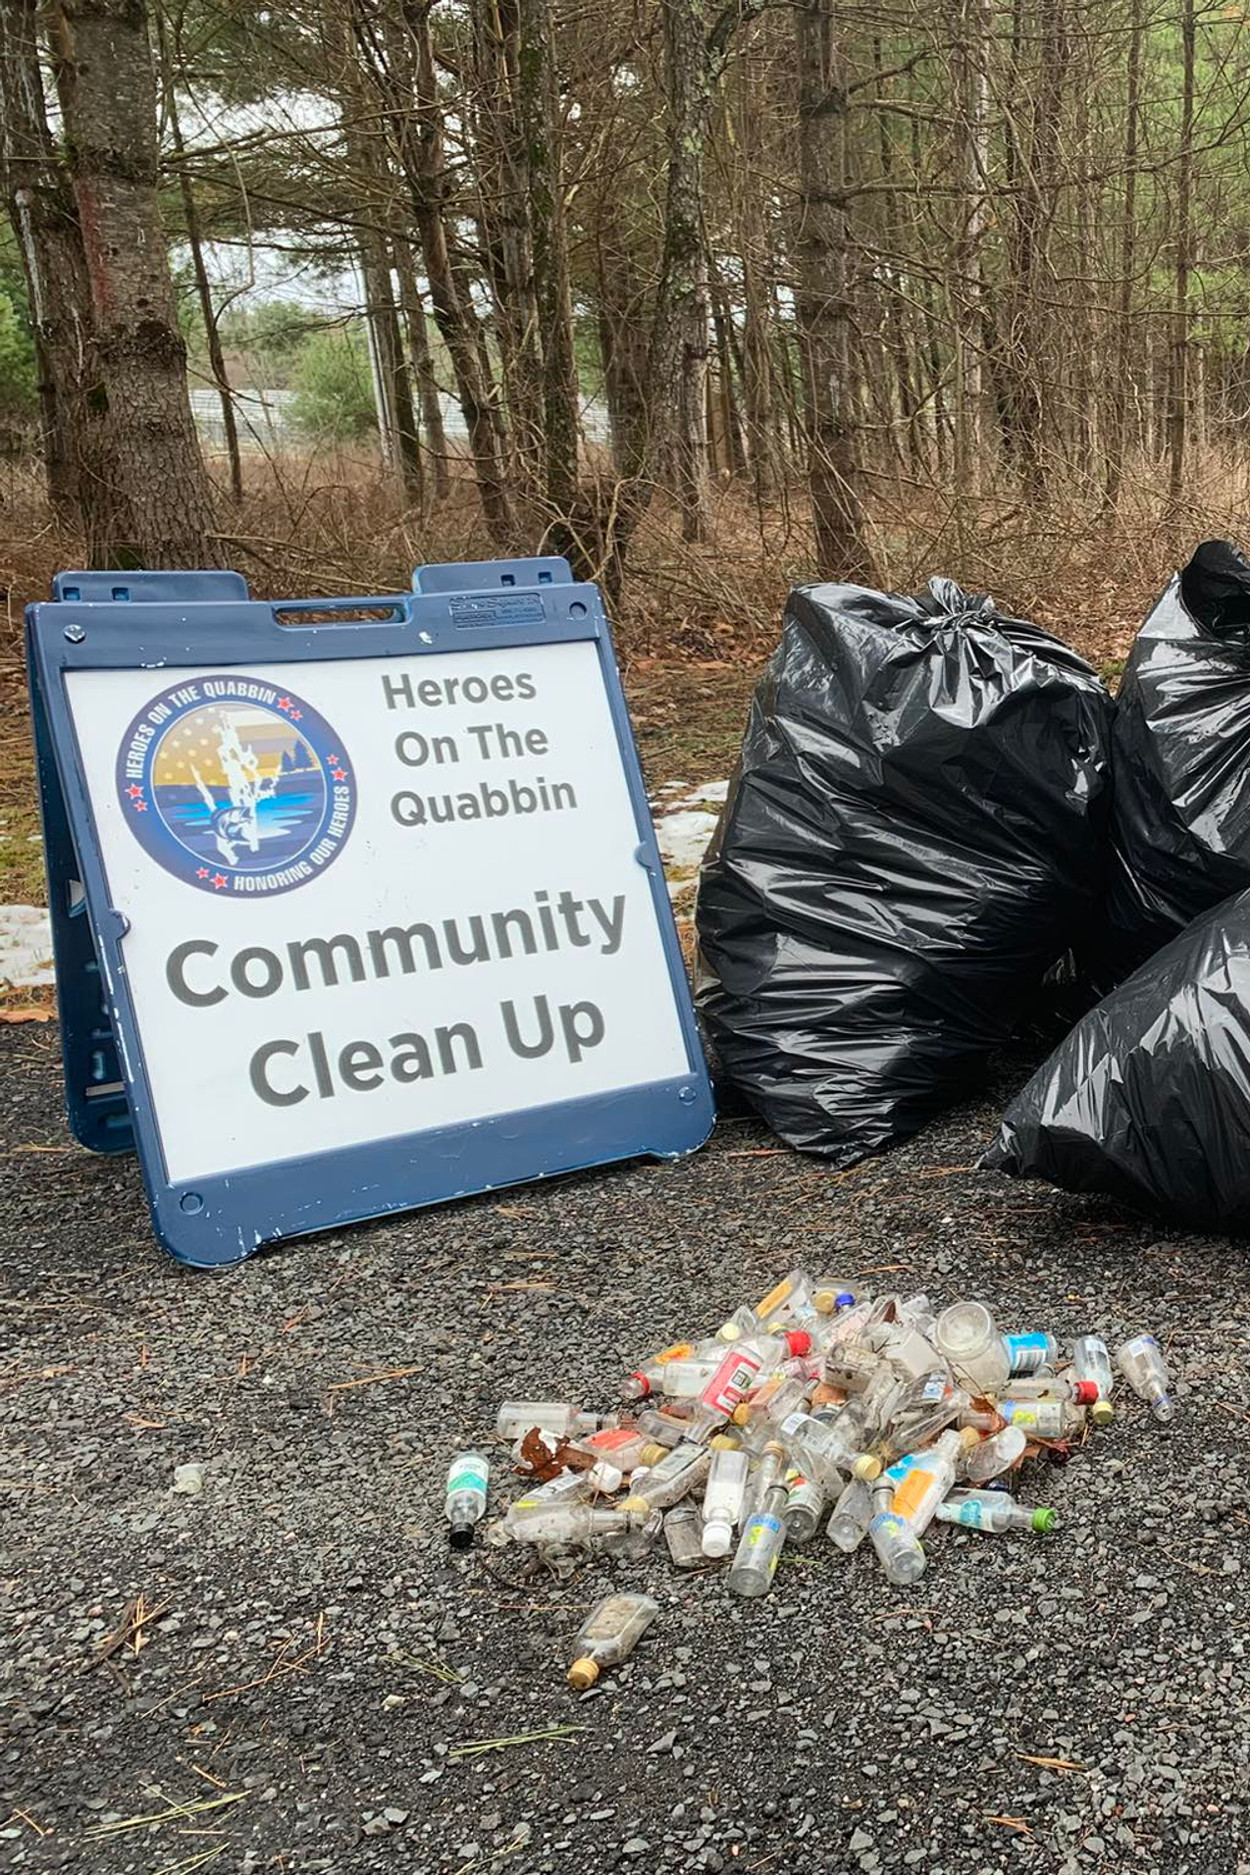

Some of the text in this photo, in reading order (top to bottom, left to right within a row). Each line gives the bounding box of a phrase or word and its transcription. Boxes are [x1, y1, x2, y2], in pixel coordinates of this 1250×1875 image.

[126, 681, 277, 779] HEROES ON THE QUABBIN
[382, 673, 536, 709] Heroes
[395, 723, 548, 767] On The
[234, 786, 350, 892] HONORING OUR HEROES
[391, 778, 577, 827] Quabbin
[166, 890, 626, 1008] Community
[249, 994, 605, 1107] Clean Up
